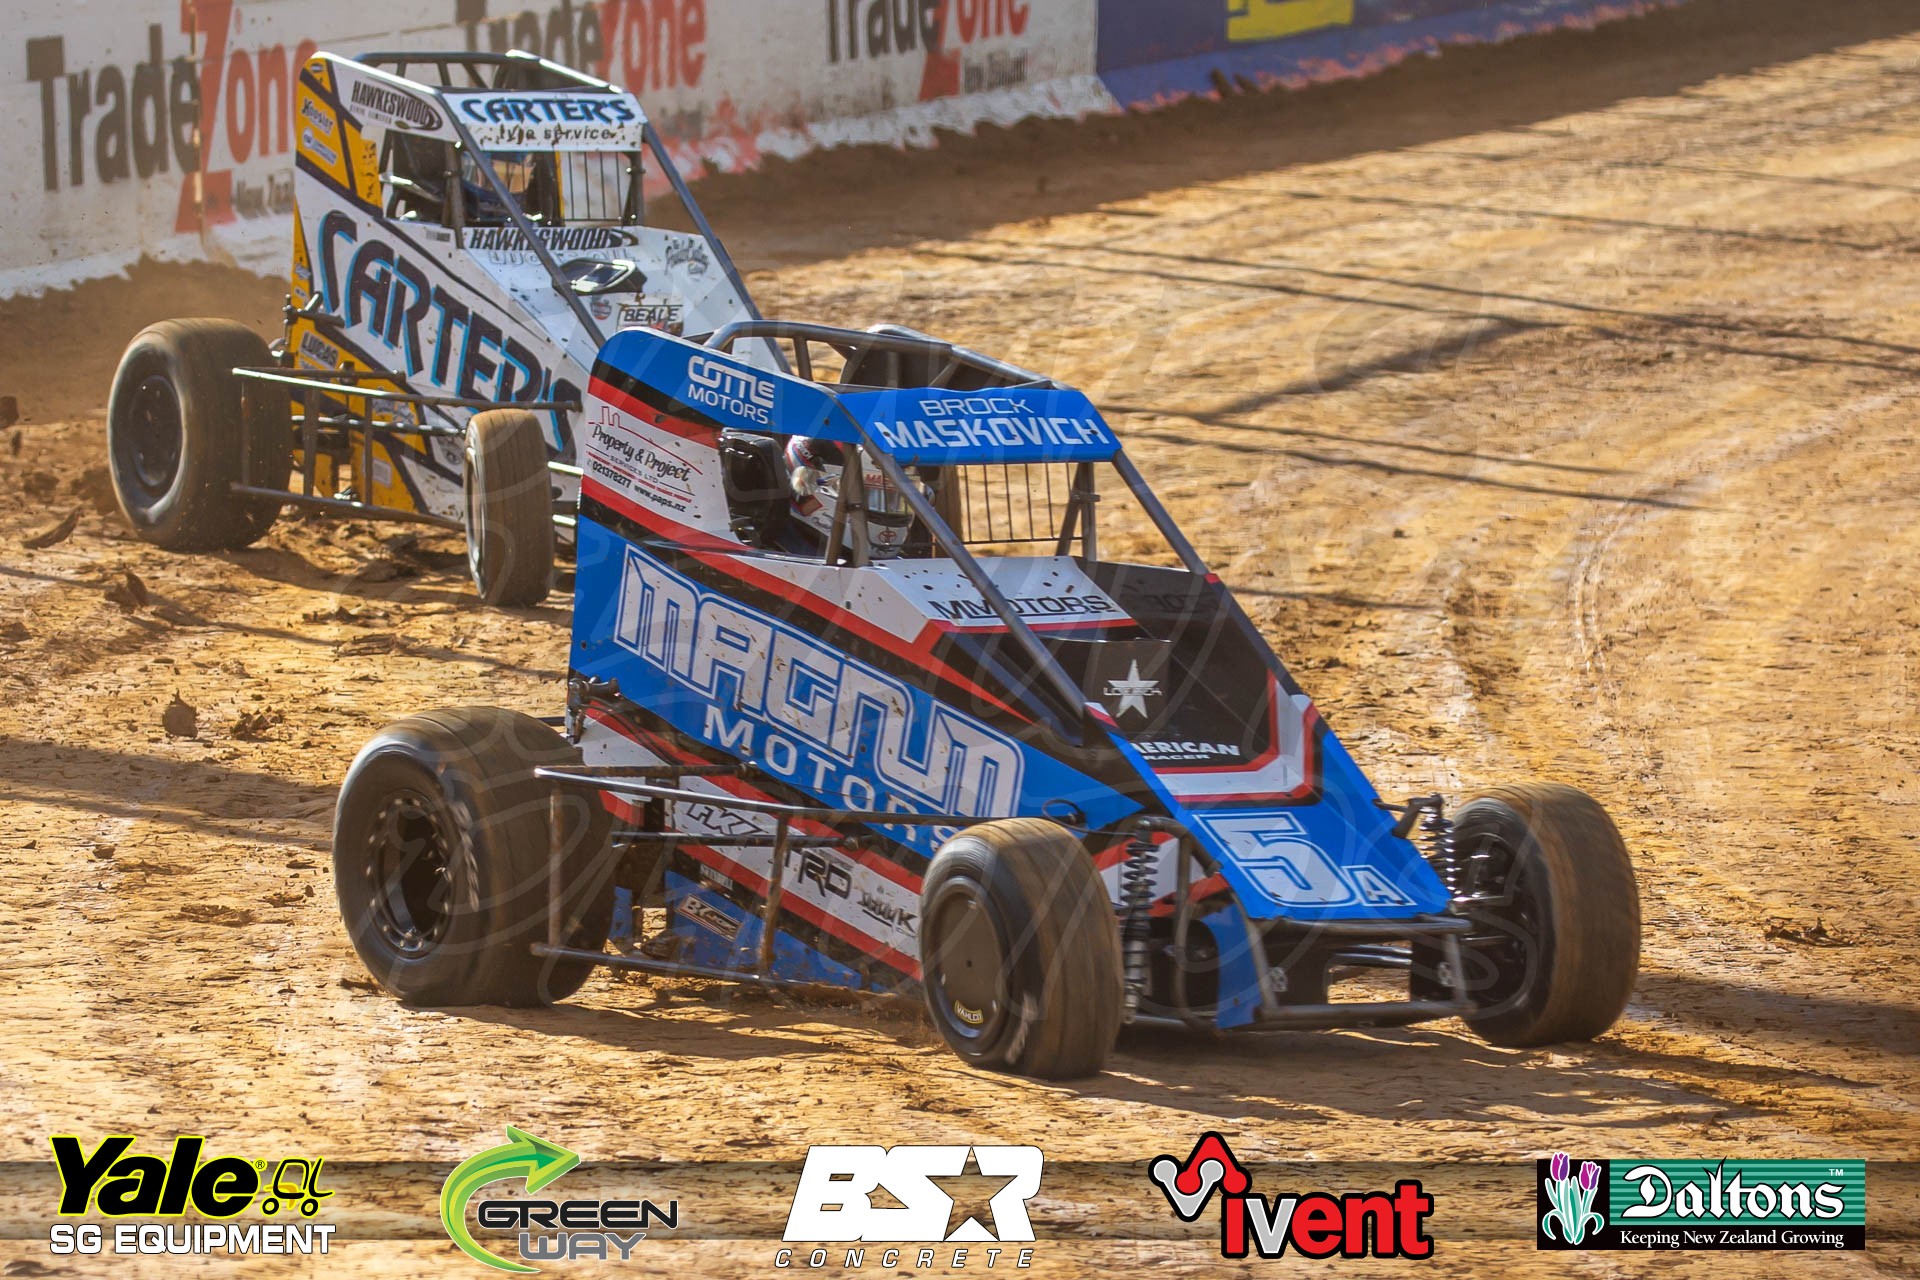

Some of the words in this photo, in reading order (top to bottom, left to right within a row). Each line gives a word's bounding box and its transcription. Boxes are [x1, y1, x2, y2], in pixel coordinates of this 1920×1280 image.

[351, 80, 431, 126] HAWKESWOOD
[461, 99, 636, 124] CARTER'S
[469, 228, 611, 250] HAWKSWOOD
[623, 307, 680, 322] BEALE
[687, 382, 770, 425] MOTORS
[918, 397, 1035, 417] BROCK
[873, 417, 1110, 448] MASKOVICH
[591, 423, 634, 463] Property
[634, 449, 654, 465] &
[644, 450, 692, 482] Project
[614, 544, 1025, 818] MAGNUM
[1130, 741, 1241, 756] ERICAN
[703, 704, 960, 854] MOTORS
